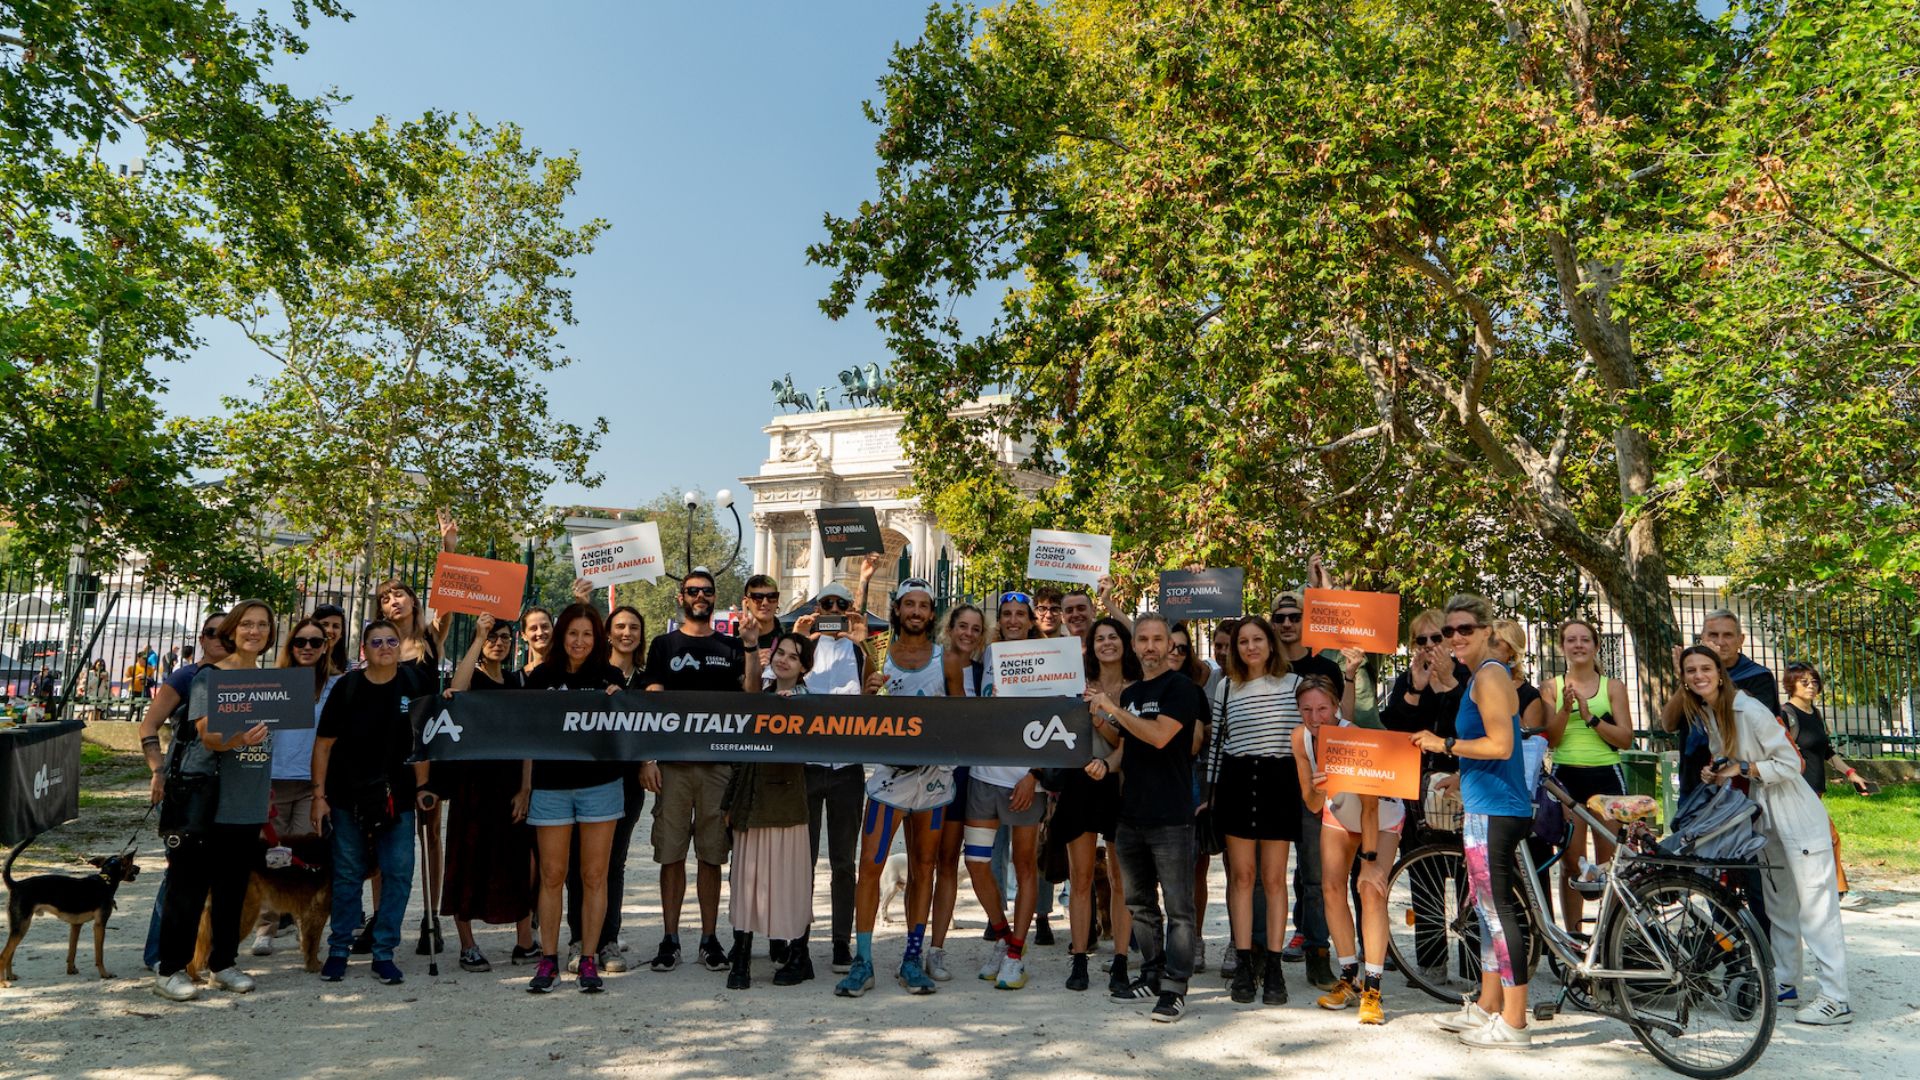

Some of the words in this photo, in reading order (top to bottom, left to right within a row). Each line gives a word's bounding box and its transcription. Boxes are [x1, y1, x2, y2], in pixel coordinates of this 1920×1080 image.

[824, 526, 841, 535] STOP
[842, 525, 867, 533] ANIMAL
[581, 548, 613, 560] ANCHE
[613, 546, 624, 554] IO
[1035, 546, 1066, 554] ANCHE
[582, 556, 614, 568] CORRO
[1035, 553, 1065, 561] CORRO
[583, 567, 600, 576] PER
[601, 564, 615, 573] GLI
[616, 556, 656, 570] ANIMALI
[1050, 561, 1064, 569] GLI
[1064, 562, 1102, 572] ANIMALI
[441, 571, 469, 582] ANCHE
[470, 575, 480, 583] IO
[440, 579, 482, 591] SOSTENGO
[438, 587, 466, 598] ESSERE
[467, 591, 501, 604] ANIMALI
[1166, 588, 1188, 597] STOP
[1189, 586, 1223, 595] ANIMAL
[1166, 596, 1193, 606] ABUSE
[1311, 607, 1339, 616] ANCHE
[1341, 609, 1351, 617] IO
[1310, 615, 1355, 626] SOSTENGO
[1310, 624, 1339, 633] ESSERE
[1340, 626, 1376, 637] ANIMALI
[1000, 659, 1033, 668] ANCHE
[1034, 657, 1045, 665] IO
[1000, 667, 1034, 677] CORRO
[1001, 676, 1019, 685] PER
[1020, 675, 1035, 683] GLI
[1036, 672, 1077, 682] ANIMALI
[217, 692, 246, 703] STOP
[248, 691, 291, 701] ANIMAL
[217, 703, 253, 713] ABUSE
[562, 711, 681, 732] RUNNING
[683, 712, 751, 734] ITALY
[754, 713, 804, 735] FOR
[806, 715, 923, 737] ANIMALS
[710, 743, 773, 751] ESSEREANIMALI
[1326, 746, 1357, 757] ANCHE
[1358, 749, 1368, 758] IO
[239, 752, 268, 762] FOOD
[1326, 755, 1373, 767] SOSTENGO
[1325, 764, 1355, 776] ESSERE
[1357, 767, 1396, 780] ANIMALI
